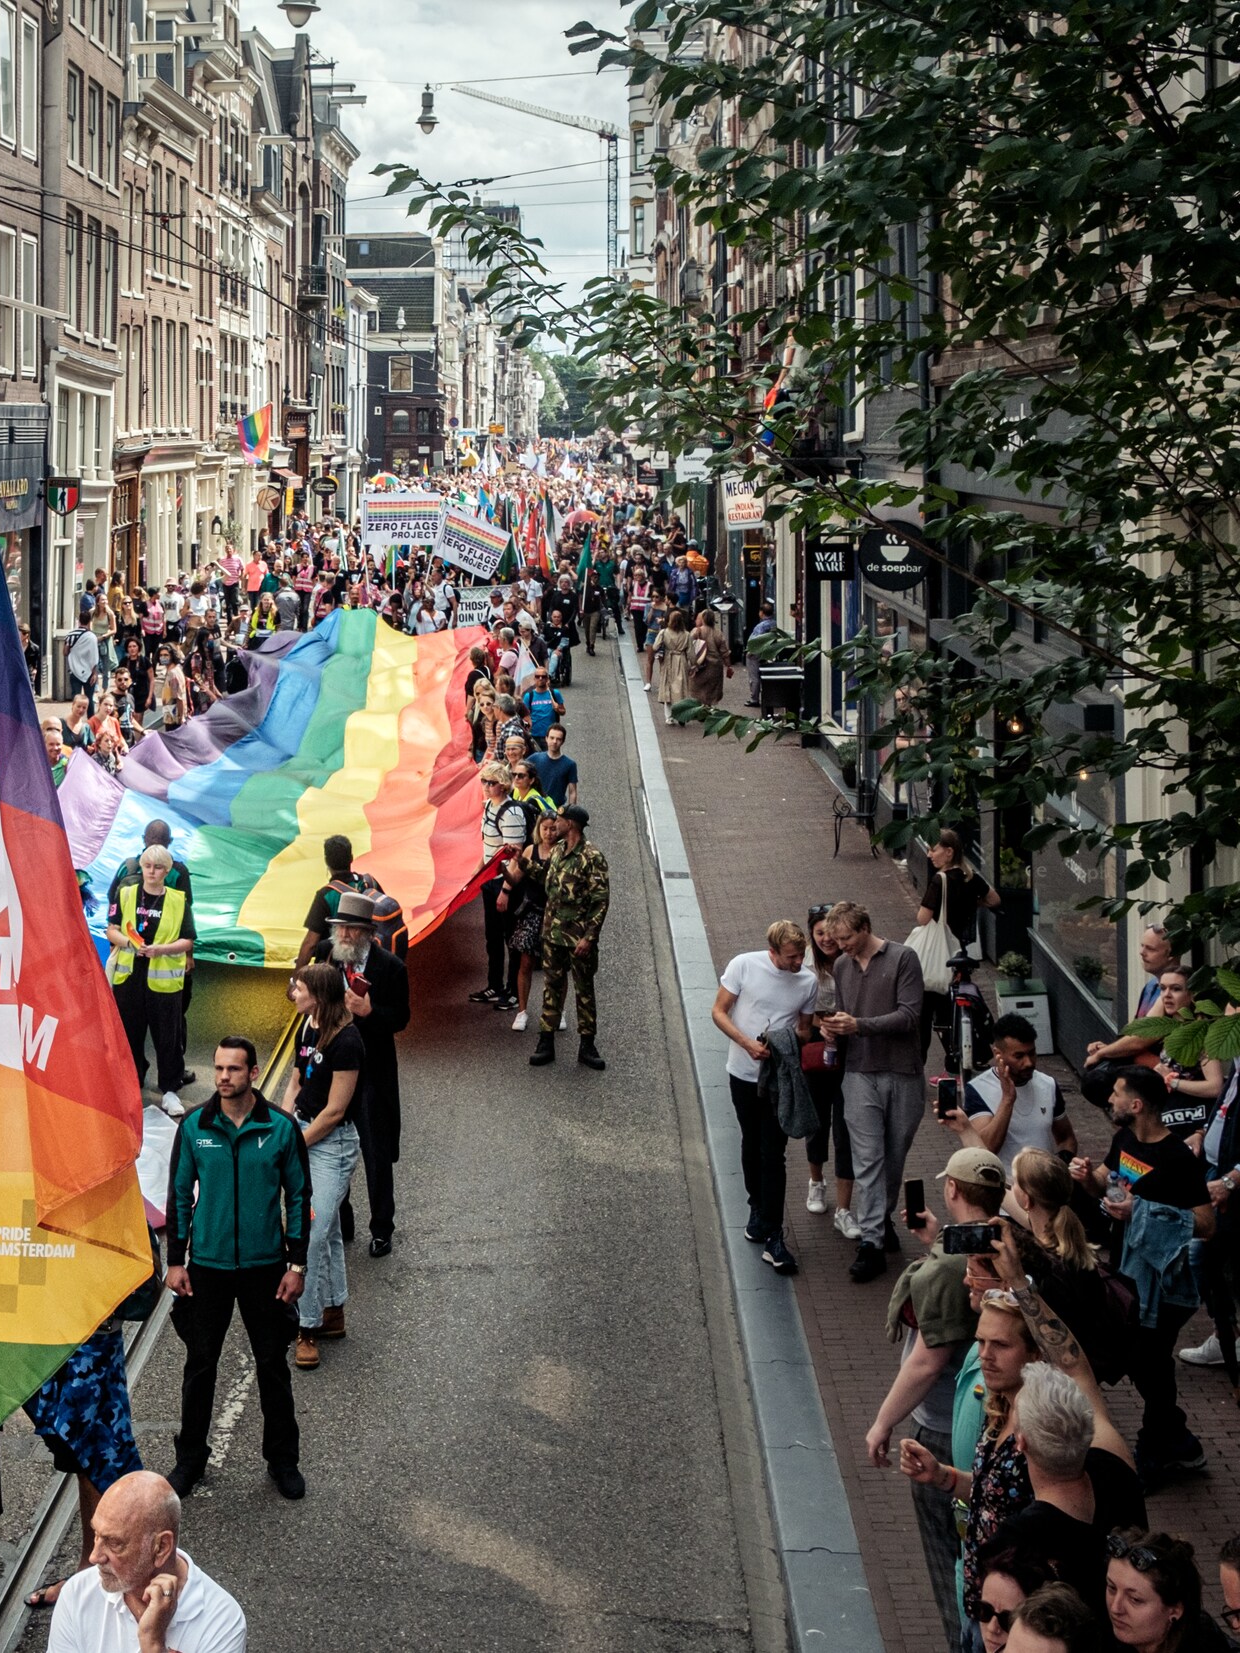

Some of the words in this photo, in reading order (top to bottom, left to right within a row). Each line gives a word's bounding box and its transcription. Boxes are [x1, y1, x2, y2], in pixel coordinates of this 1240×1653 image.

[734, 503, 755, 511] INDIAN
[728, 510, 763, 521] RESTAURANT
[367, 523, 398, 531] ZERO
[400, 522, 438, 531] FLAGS
[391, 531, 438, 539] PROJECT
[443, 536, 467, 553] ZERO
[467, 548, 498, 567] FLAGS
[458, 553, 495, 575] PROJECT
[815, 562, 846, 572] WARE
[866, 563, 879, 572] de
[881, 563, 922, 574] soepbar
[458, 612, 474, 622] OIN
[1121, 1156, 1148, 1175] GUESS
